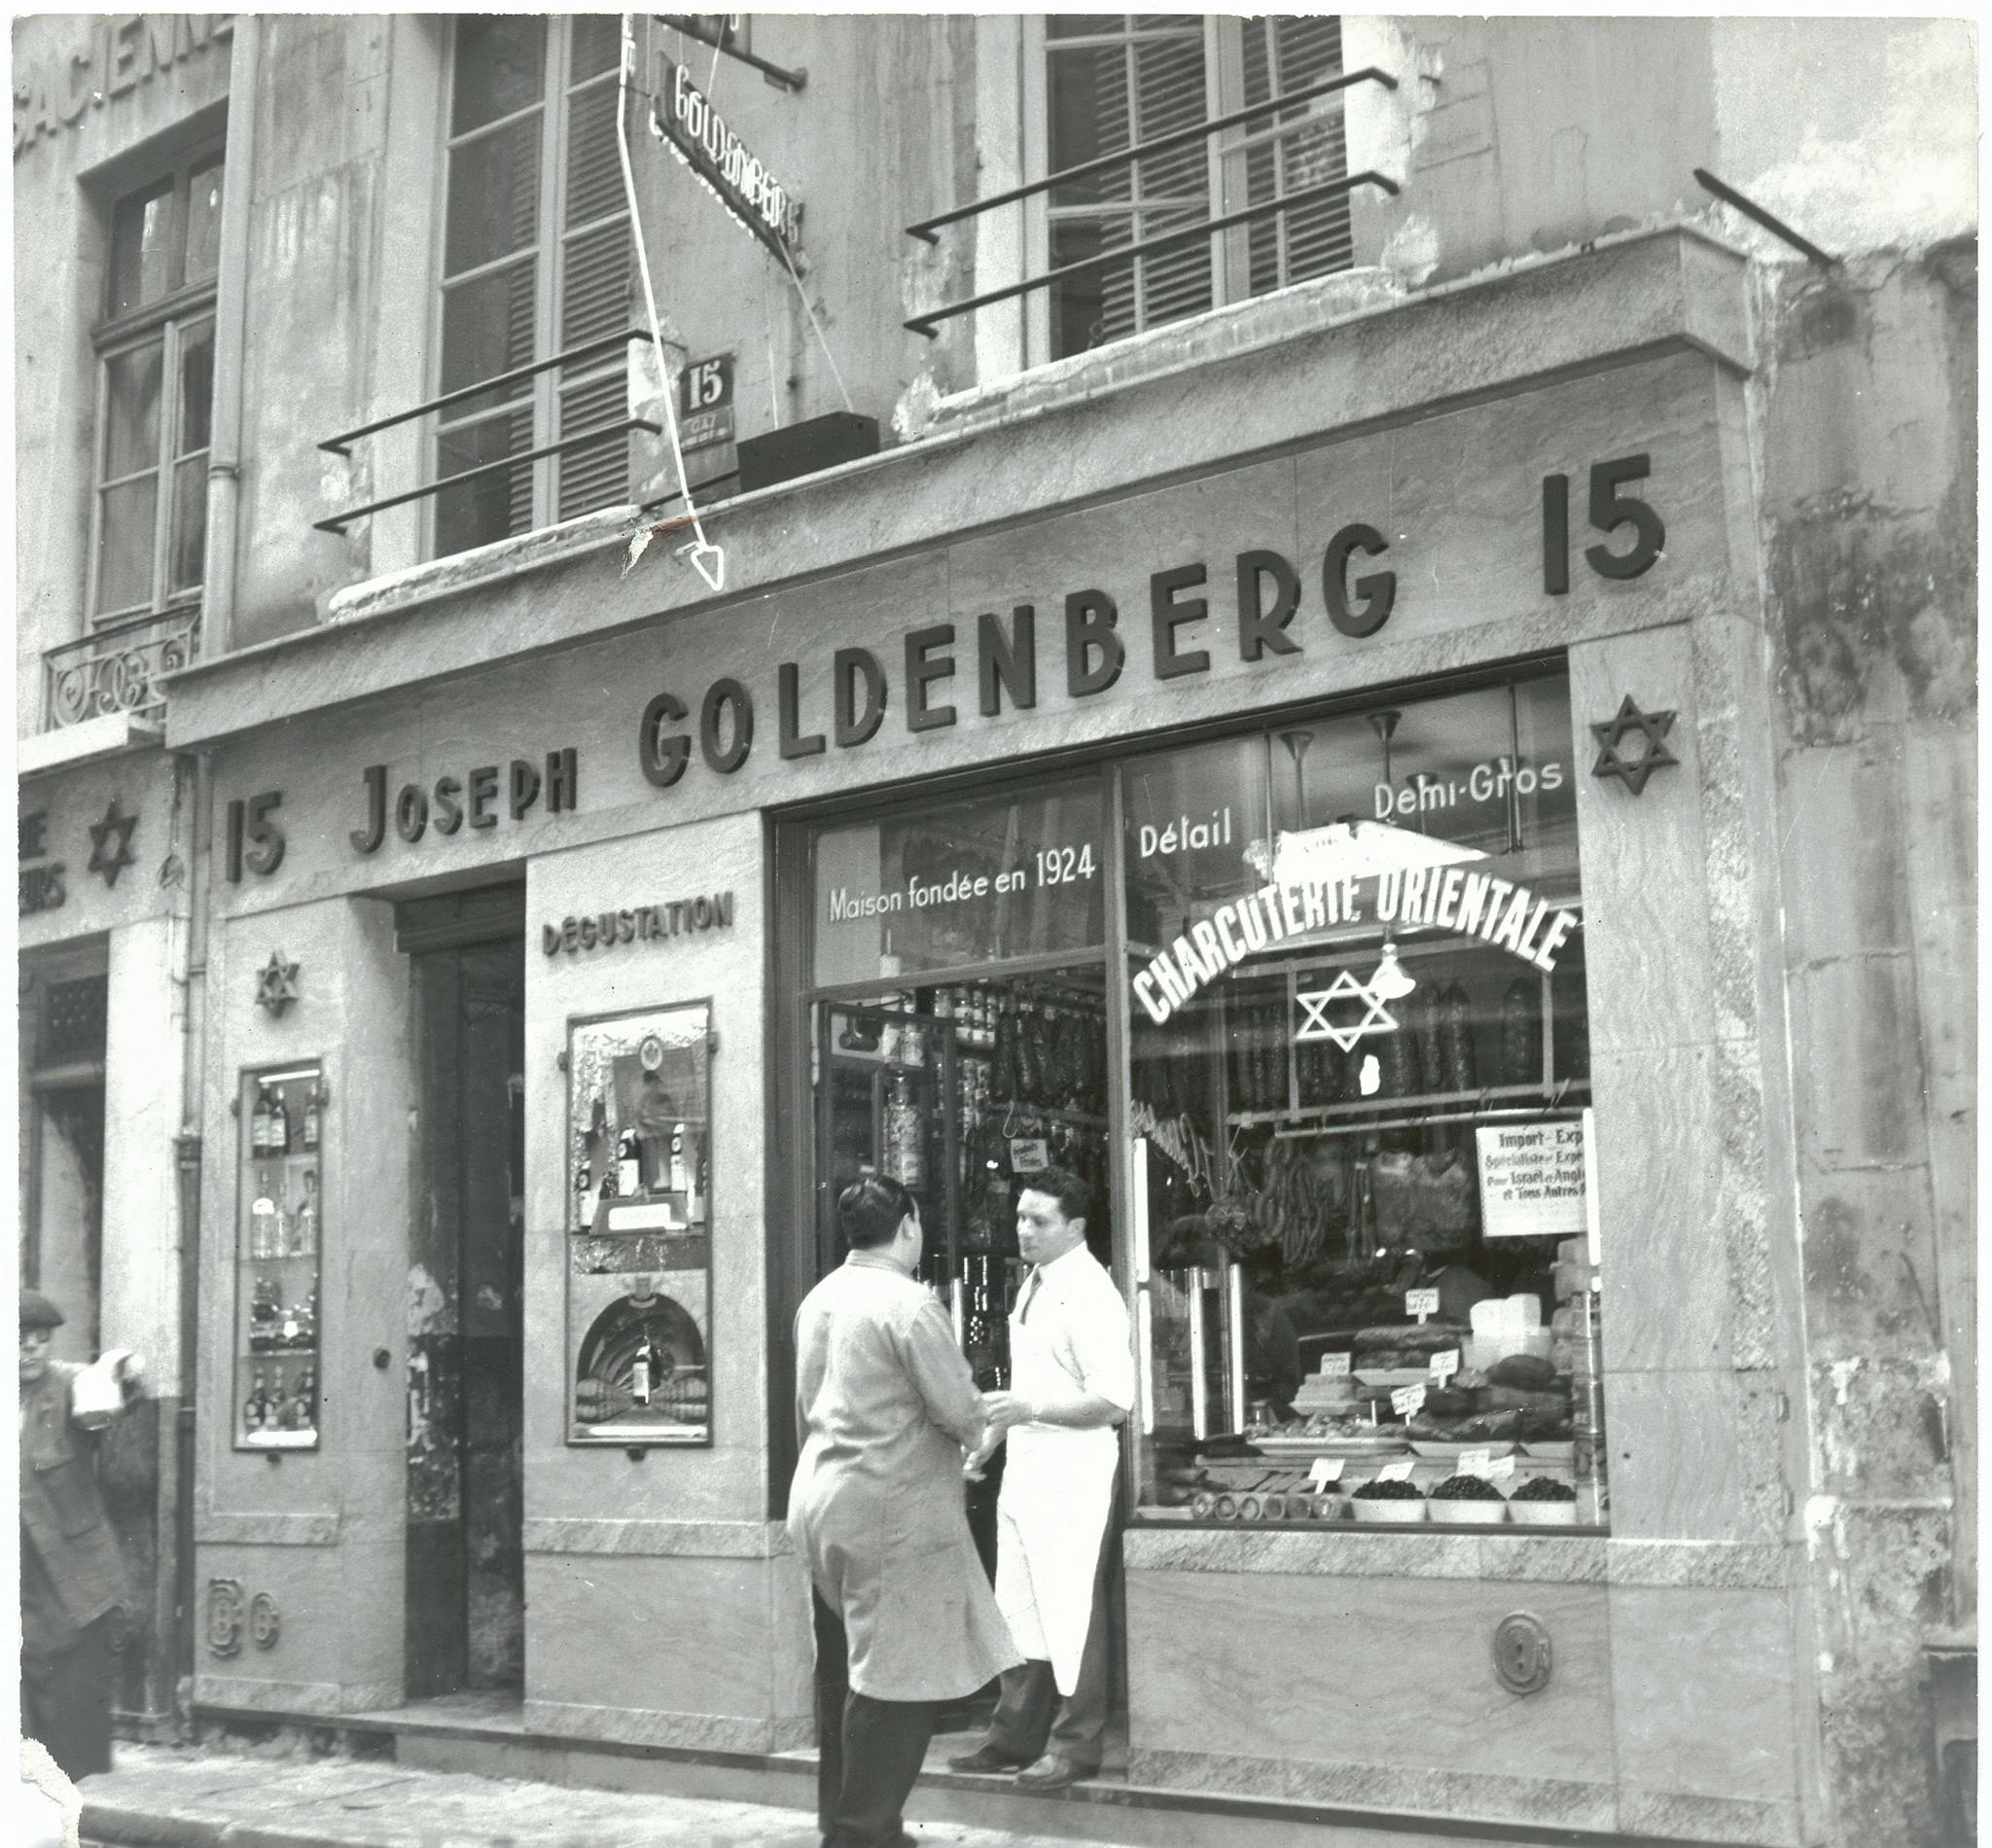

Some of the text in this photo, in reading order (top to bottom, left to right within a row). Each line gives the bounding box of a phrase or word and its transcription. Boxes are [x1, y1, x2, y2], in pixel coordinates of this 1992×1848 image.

[690, 360, 723, 409] 15
[226, 453, 1665, 884] 15 JOSEPH GOLDENBERG 15
[1139, 806, 1231, 858] Détail
[830, 843, 1095, 922] Maison fondée en 1924
[1133, 865, 1580, 1024] CHARCUTERIE ORIENTALE
[1499, 1131, 1544, 1149] Import
